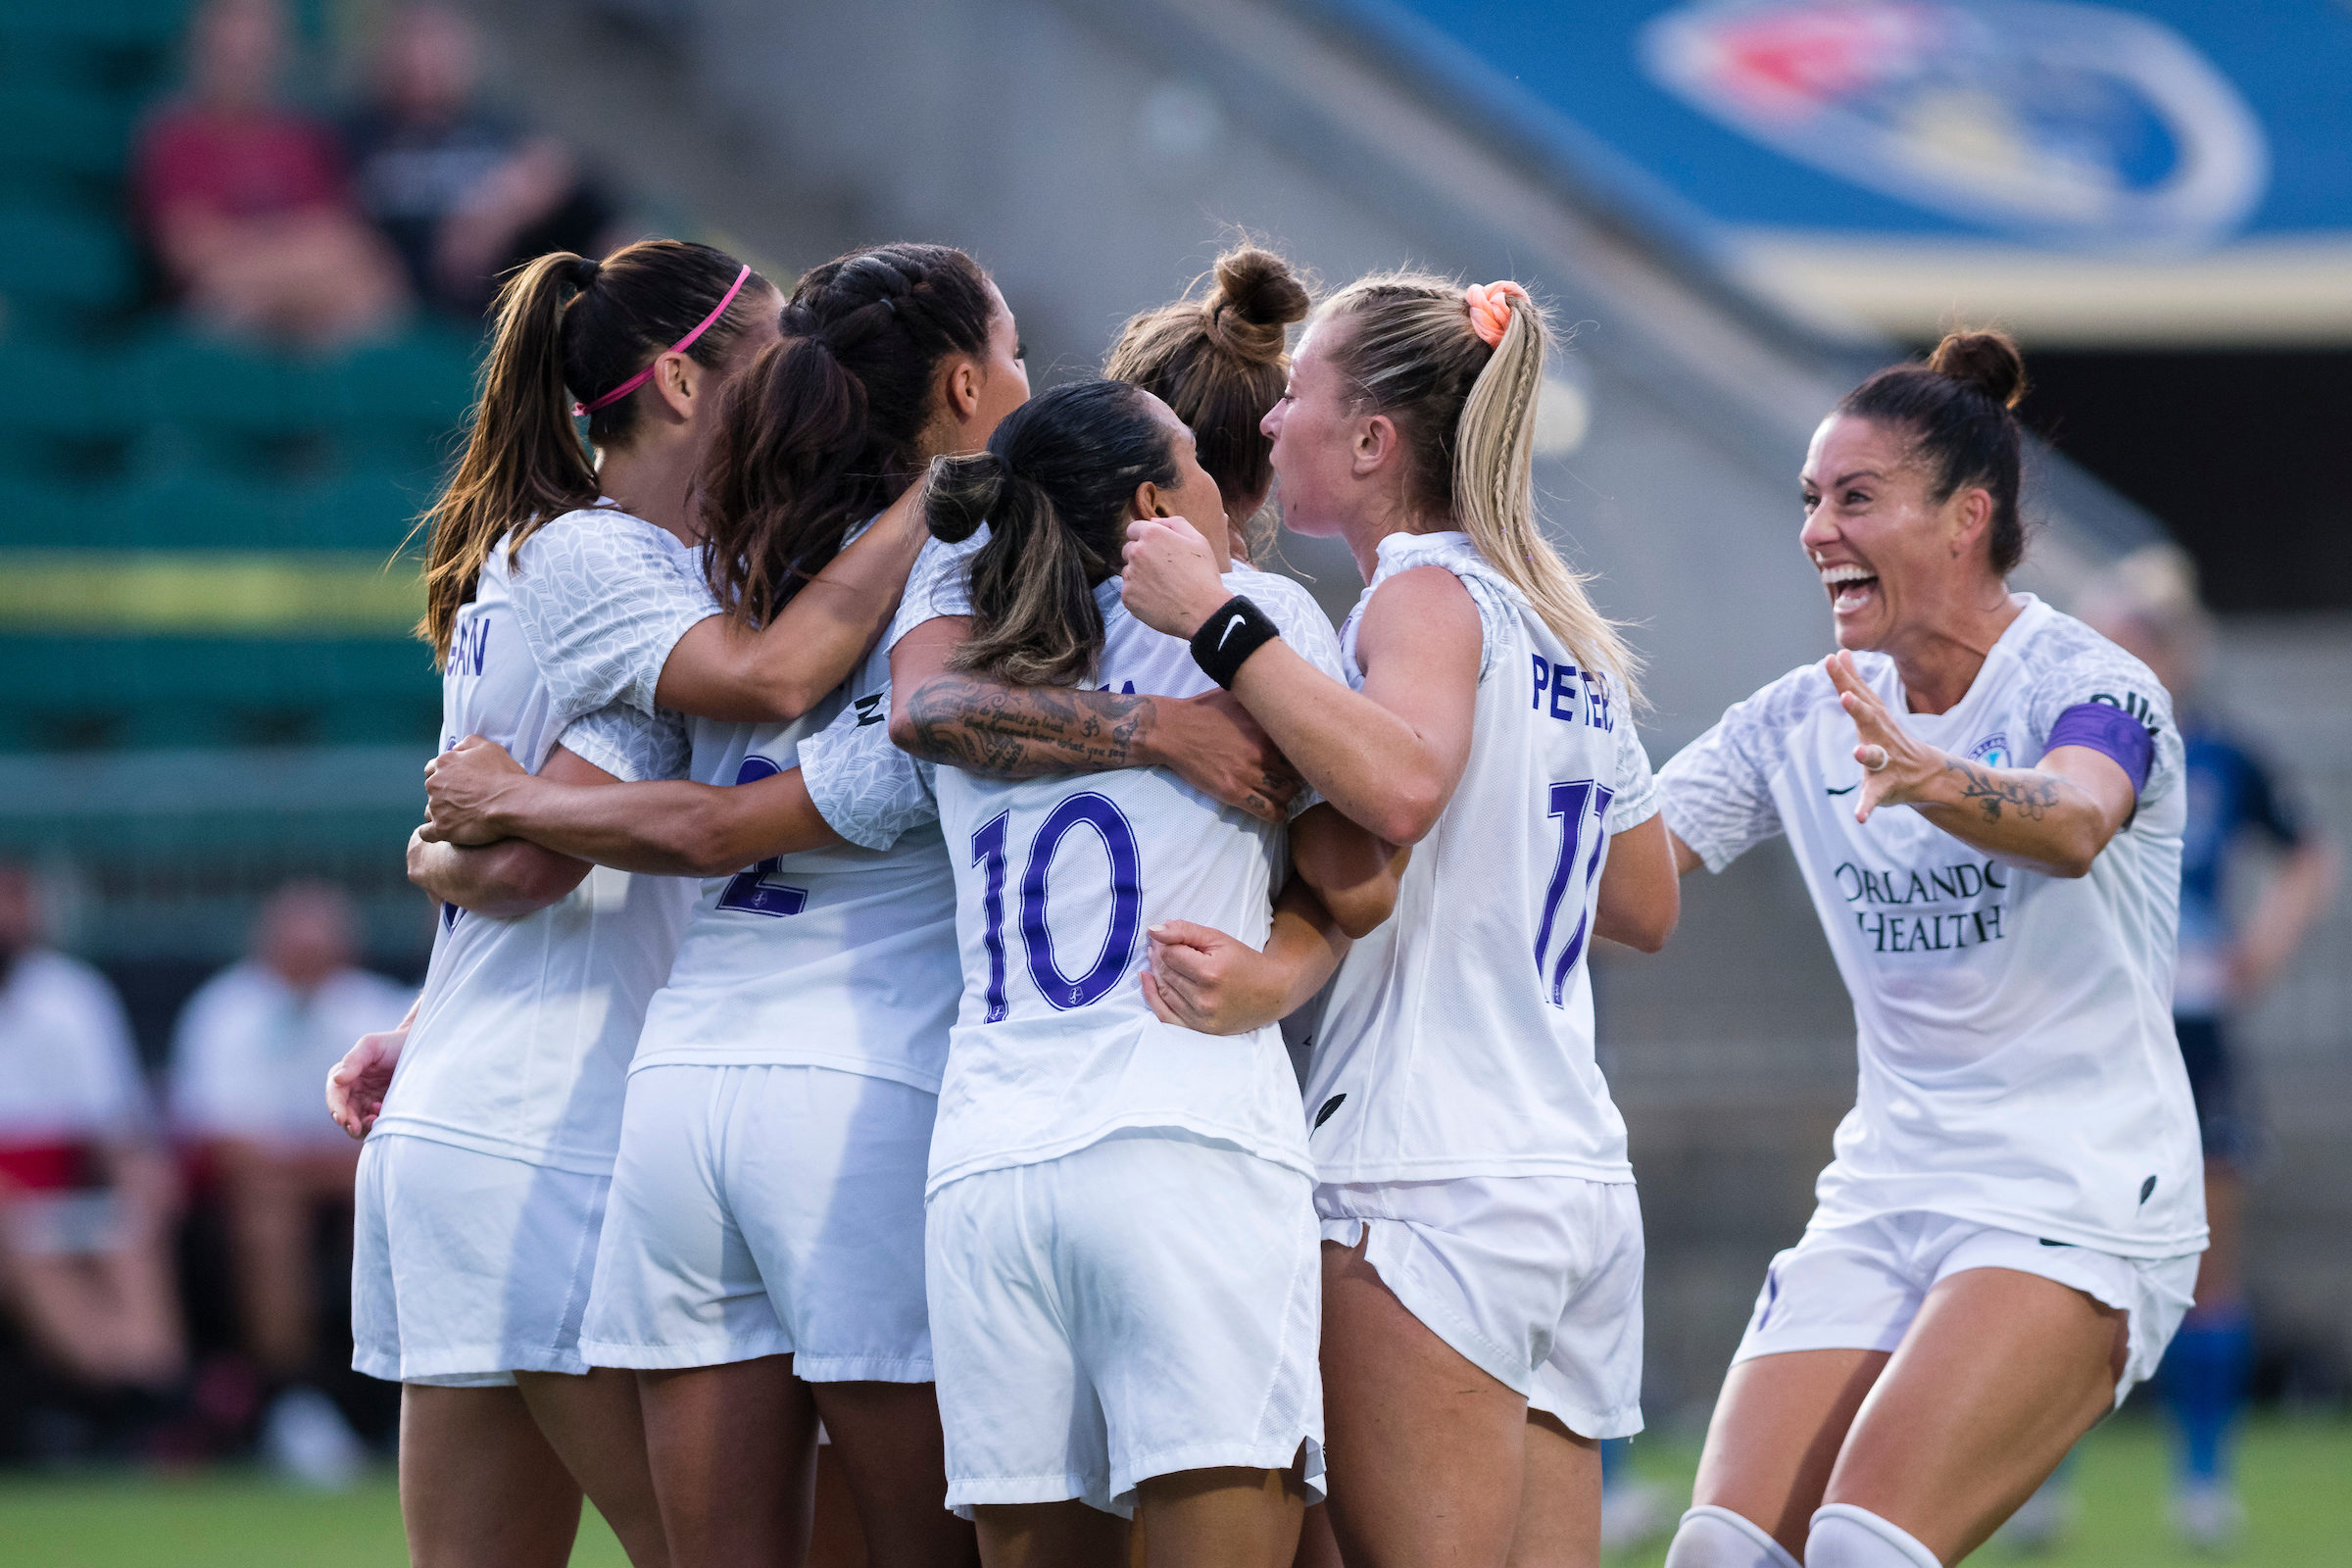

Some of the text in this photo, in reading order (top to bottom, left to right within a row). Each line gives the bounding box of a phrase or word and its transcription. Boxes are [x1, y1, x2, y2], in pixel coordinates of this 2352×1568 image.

[1531, 653, 1615, 734] PETER
[1087, 747, 1105, 760] you
[971, 791, 1143, 1025] 10
[1855, 905, 2006, 953] HEALTH
